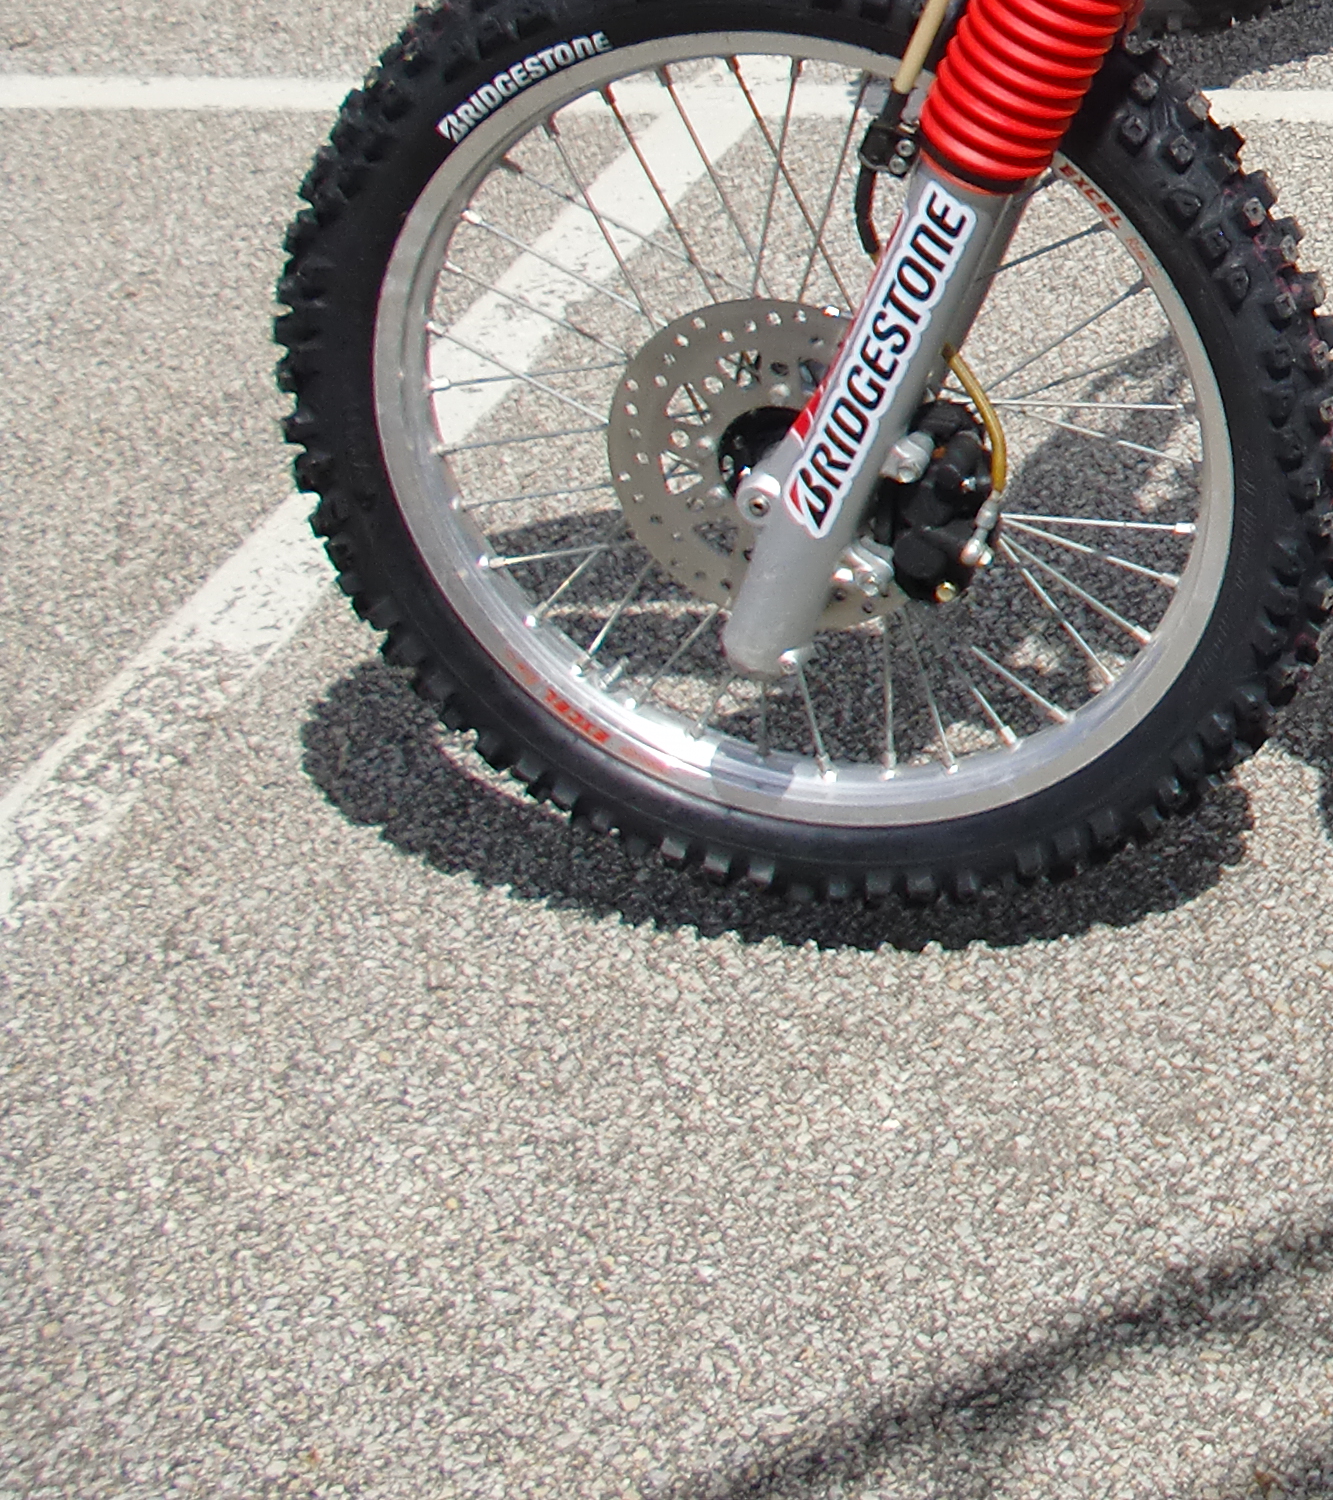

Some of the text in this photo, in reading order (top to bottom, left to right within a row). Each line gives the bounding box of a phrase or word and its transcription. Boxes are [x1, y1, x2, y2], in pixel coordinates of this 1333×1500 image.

[435, 30, 612, 144] BRIDGESTONE
[1058, 163, 1122, 229] EXCEL
[788, 190, 968, 530] BRIDGESTONE
